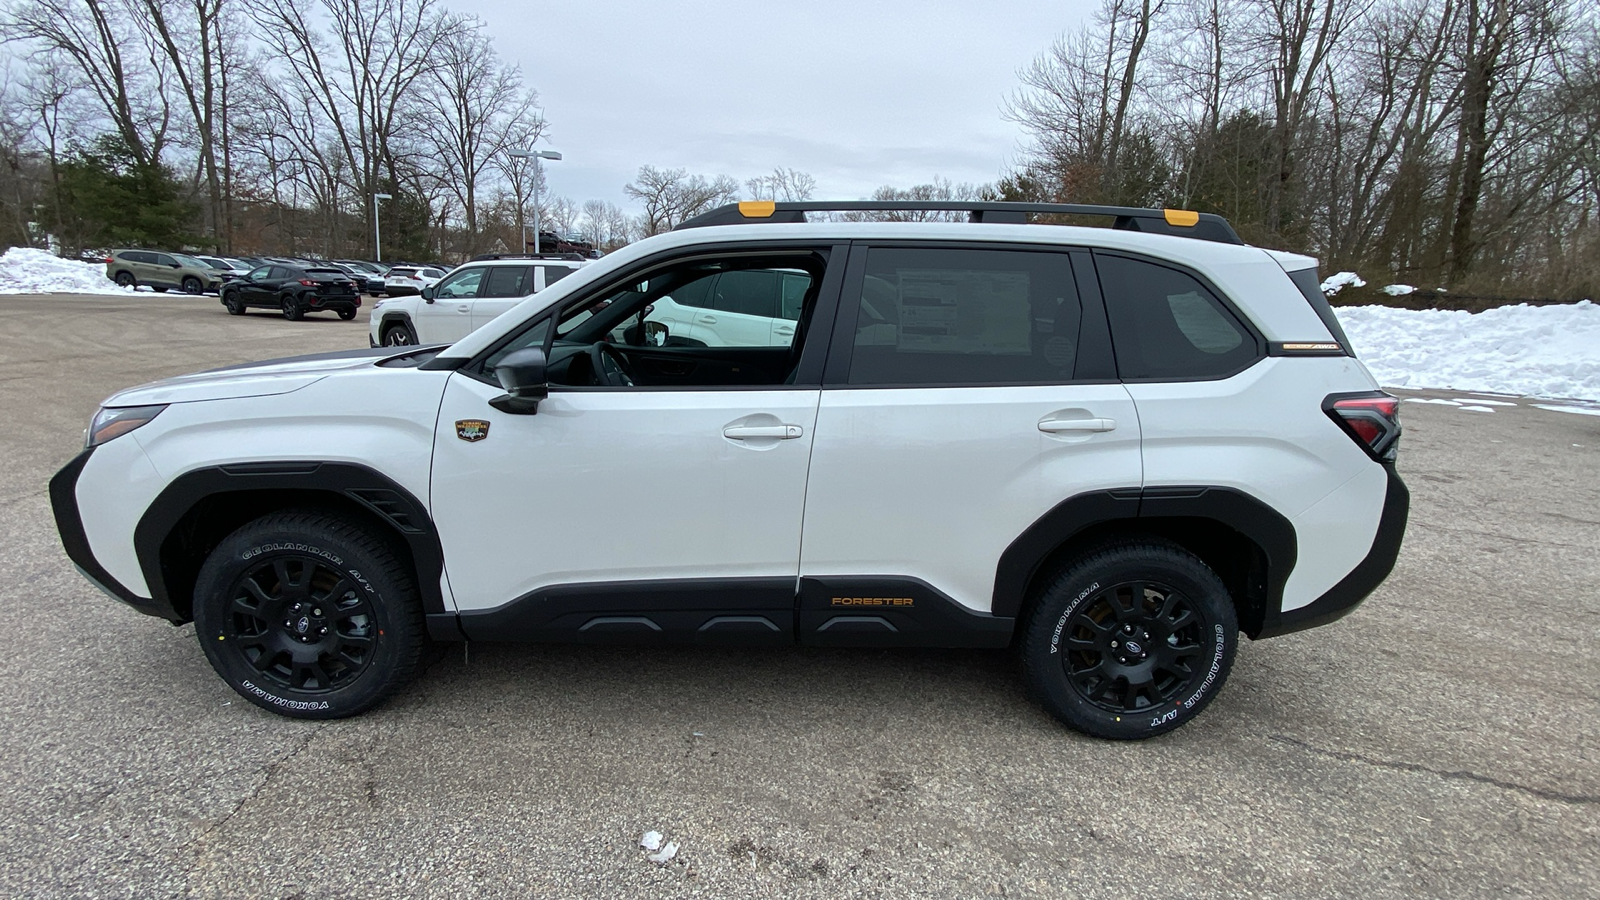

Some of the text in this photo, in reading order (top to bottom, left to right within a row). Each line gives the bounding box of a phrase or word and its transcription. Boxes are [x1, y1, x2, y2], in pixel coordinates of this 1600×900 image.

[242, 543, 375, 593] GEOLANDAR A/T
[832, 597, 914, 606] FORESTER
[1050, 582, 1100, 654] YOKOHAMA
[242, 679, 330, 710] YOKOHAMA
[1150, 623, 1225, 727] GEOLANDAR A/T
